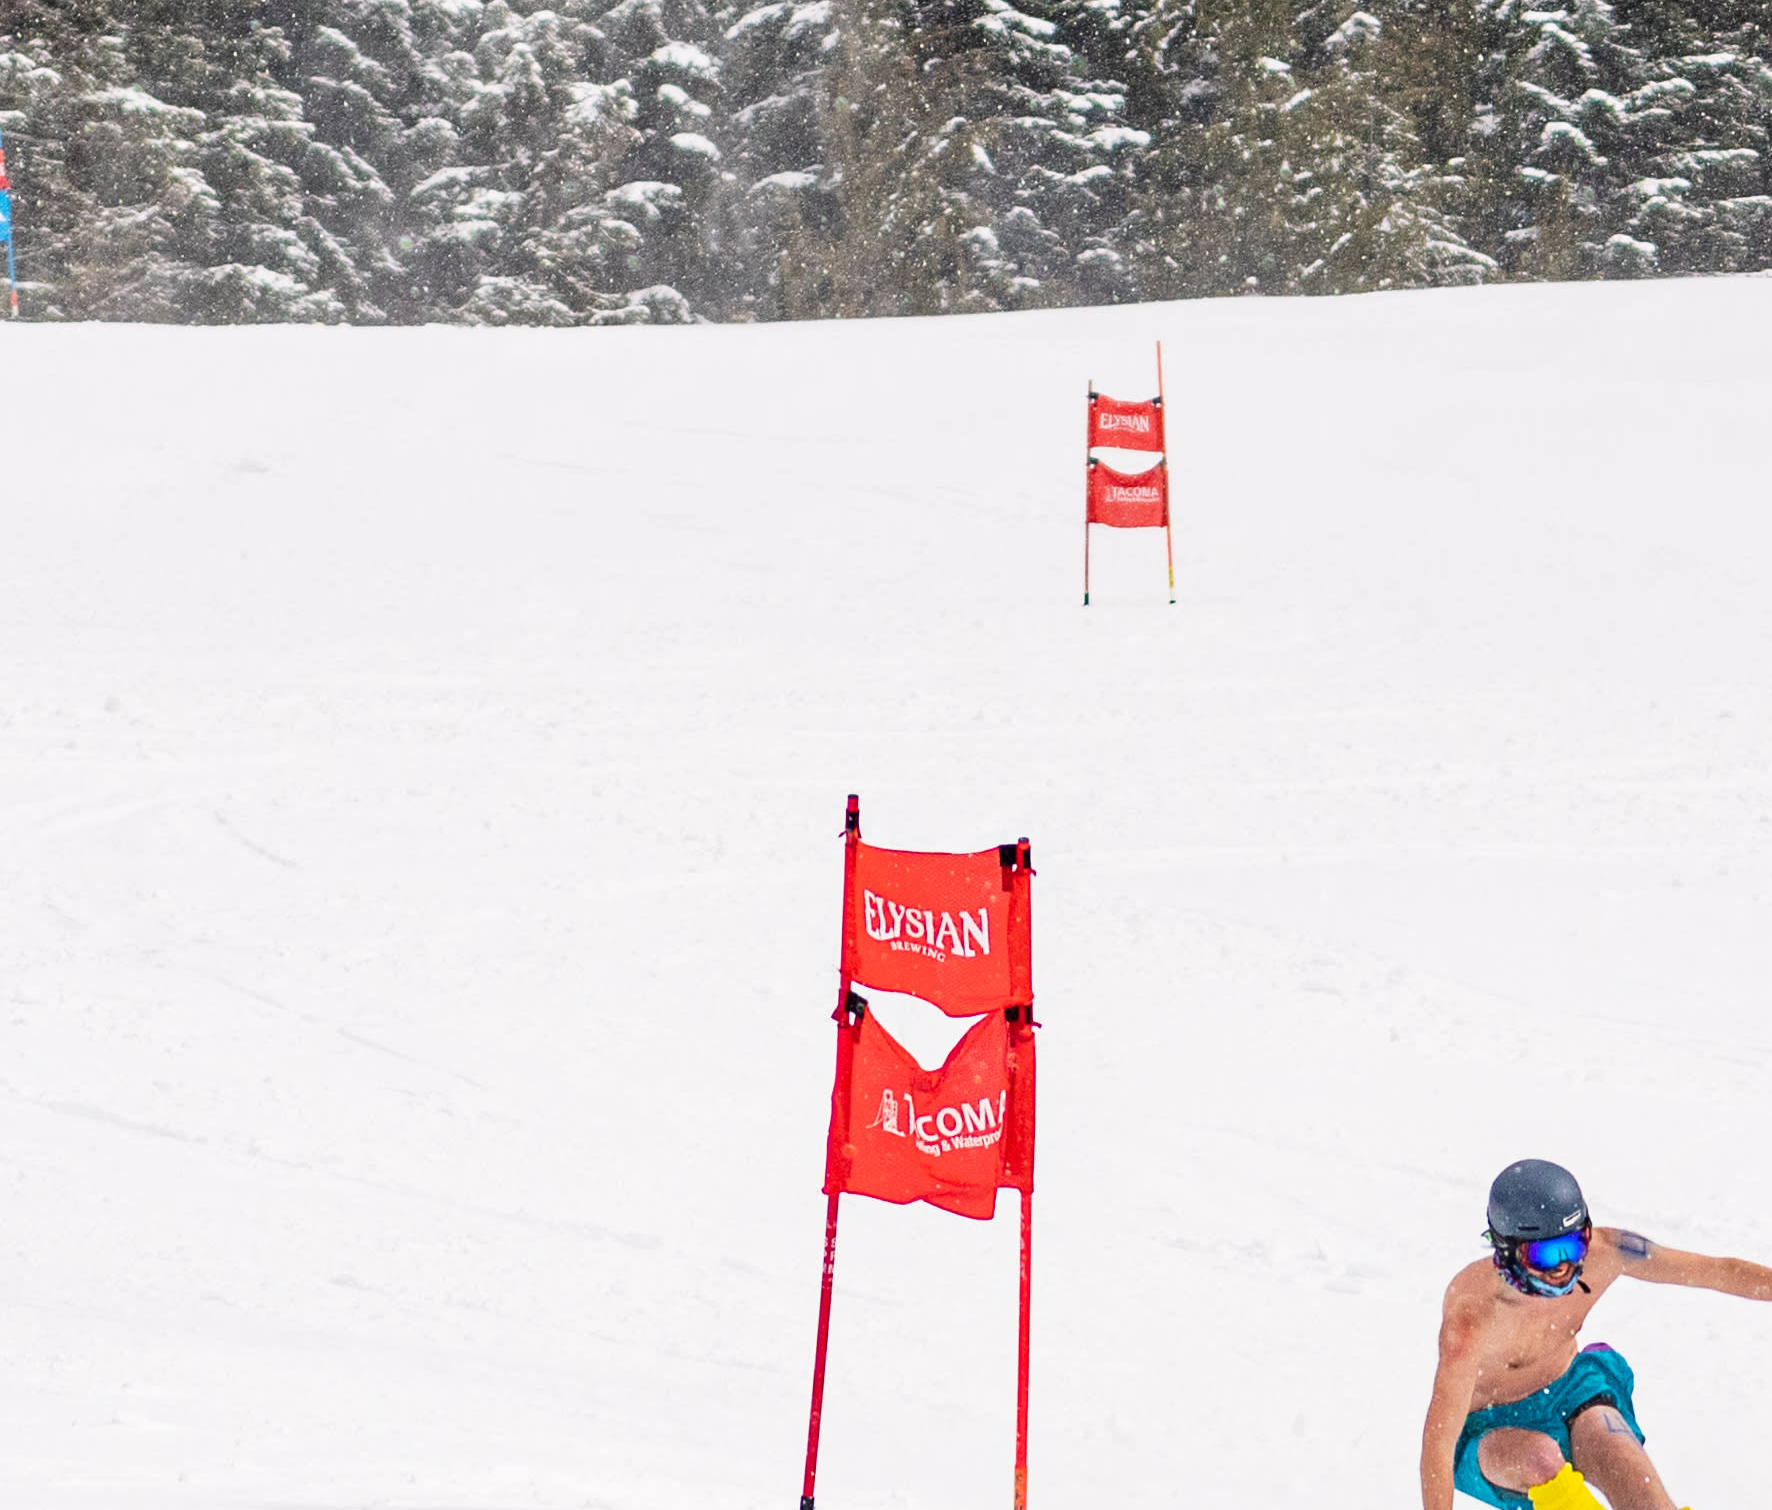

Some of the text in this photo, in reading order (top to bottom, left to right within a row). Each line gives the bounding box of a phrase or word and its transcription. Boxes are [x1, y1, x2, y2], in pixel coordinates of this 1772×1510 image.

[1100, 413, 1150, 433] ELYSIAN
[1112, 486, 1159, 502] TACOMA
[864, 889, 990, 958] ELYSIAN
[890, 941, 946, 962] BREWING
[940, 1139, 951, 1152] &
[950, 1129, 1001, 1149] Waterpro
